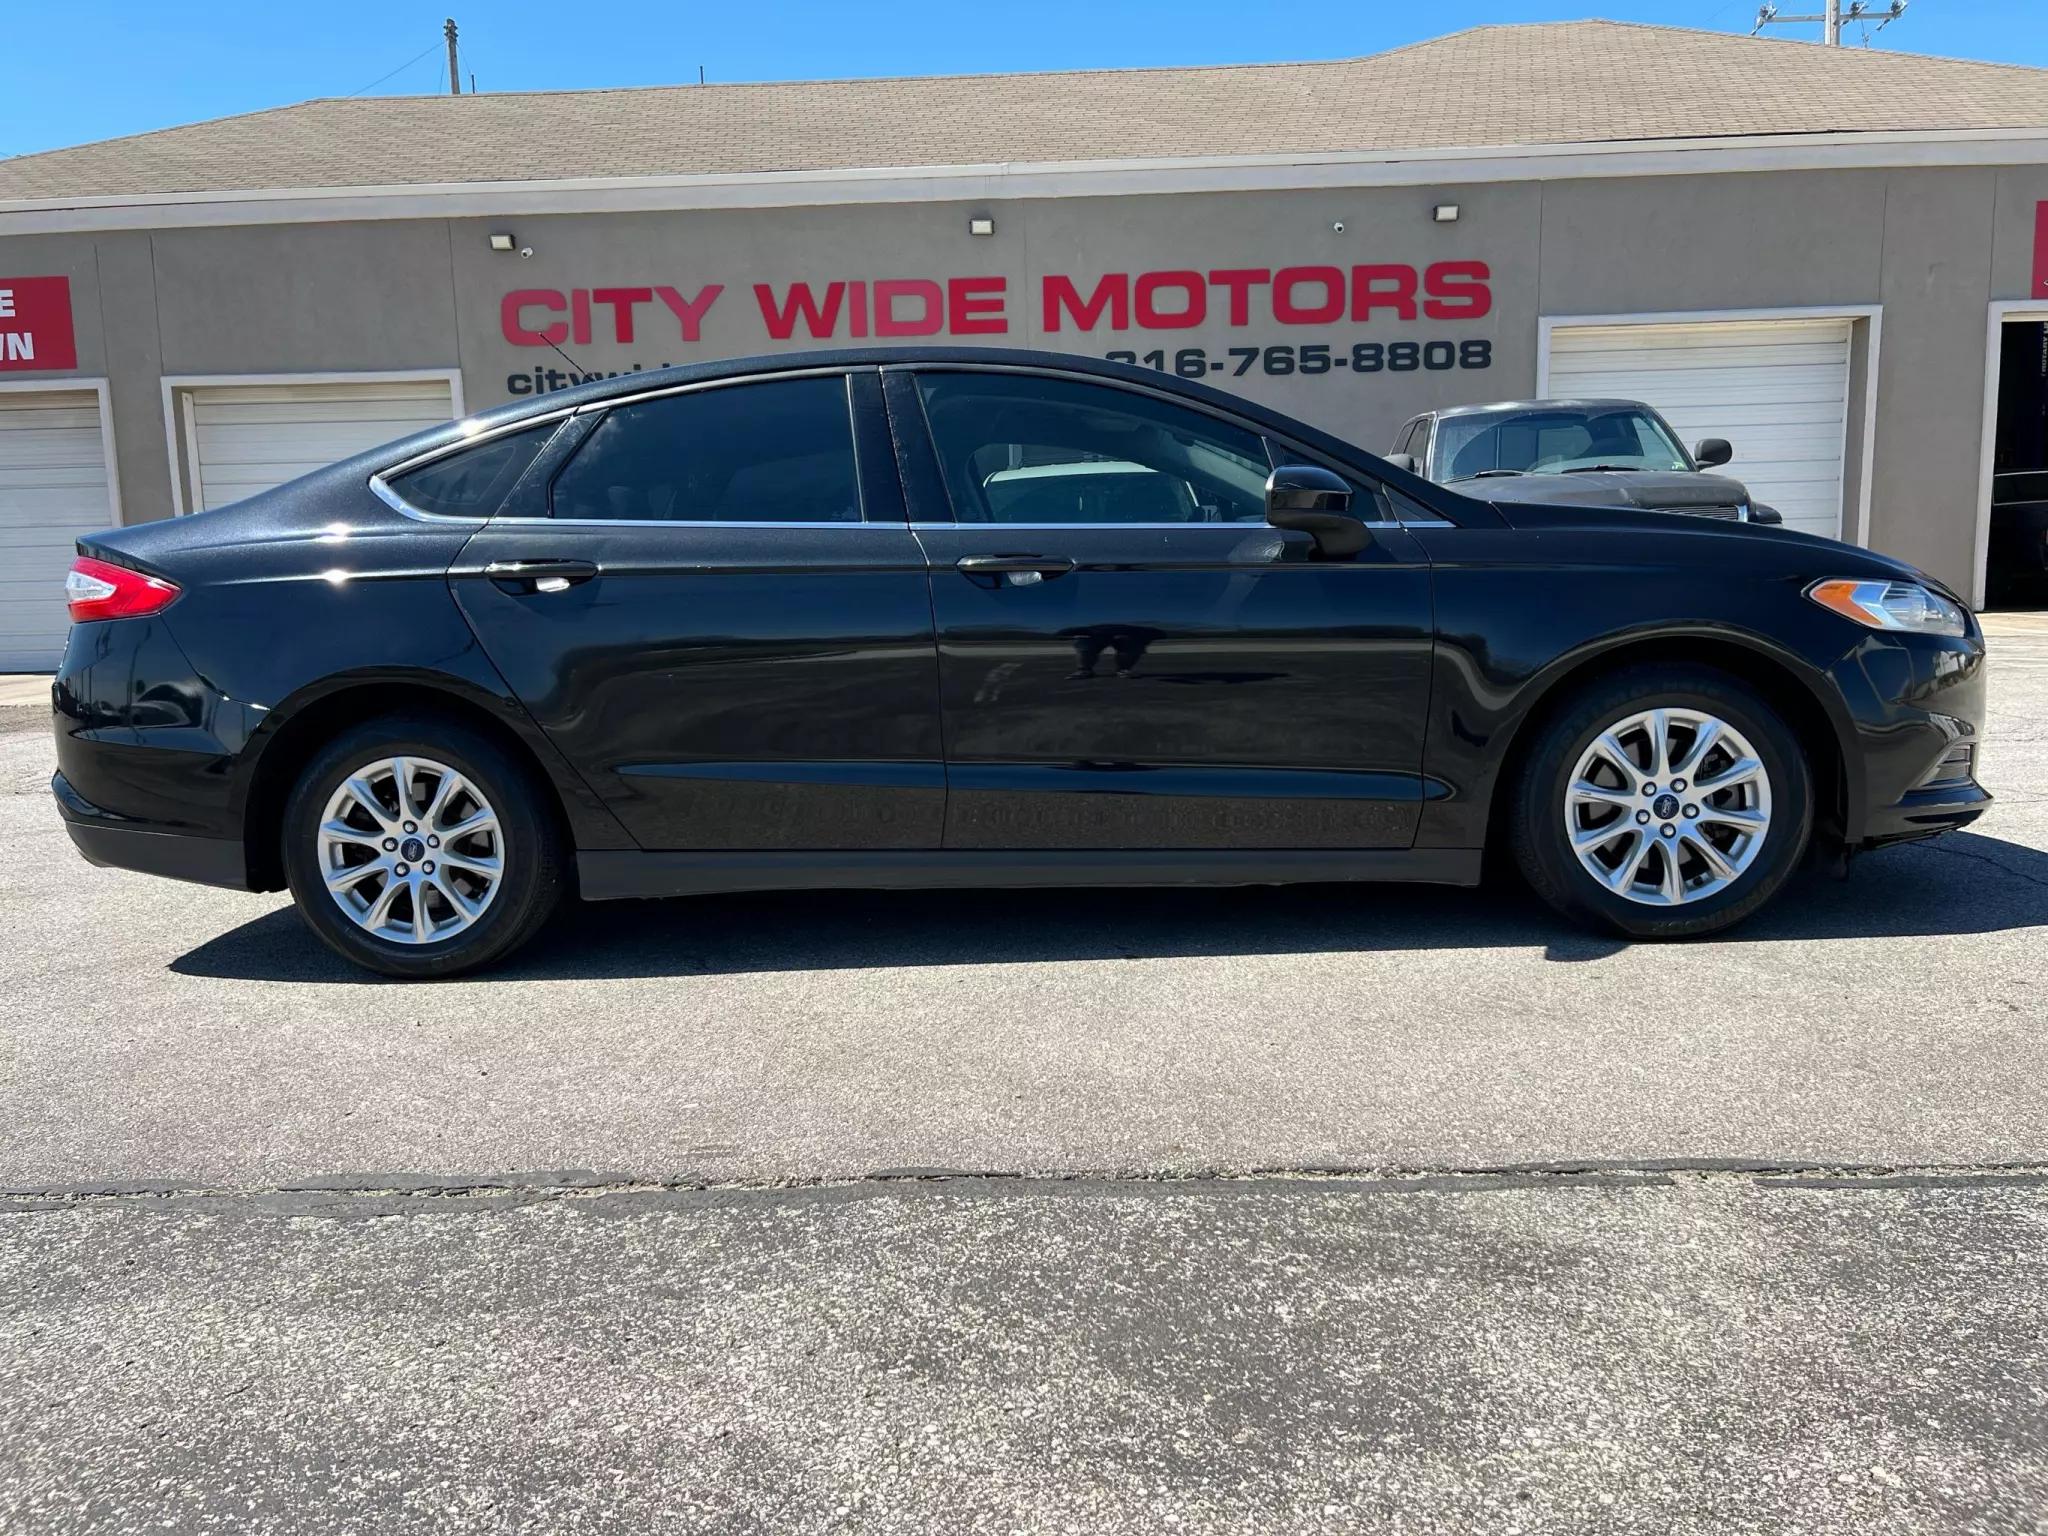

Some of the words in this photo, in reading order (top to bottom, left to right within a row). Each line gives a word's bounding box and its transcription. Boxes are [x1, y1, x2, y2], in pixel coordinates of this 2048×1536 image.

[501, 285, 724, 347] CITY
[753, 277, 1008, 340] WIDE
[1043, 260, 1492, 332] MOTORS
[0, 332, 35, 361] N
